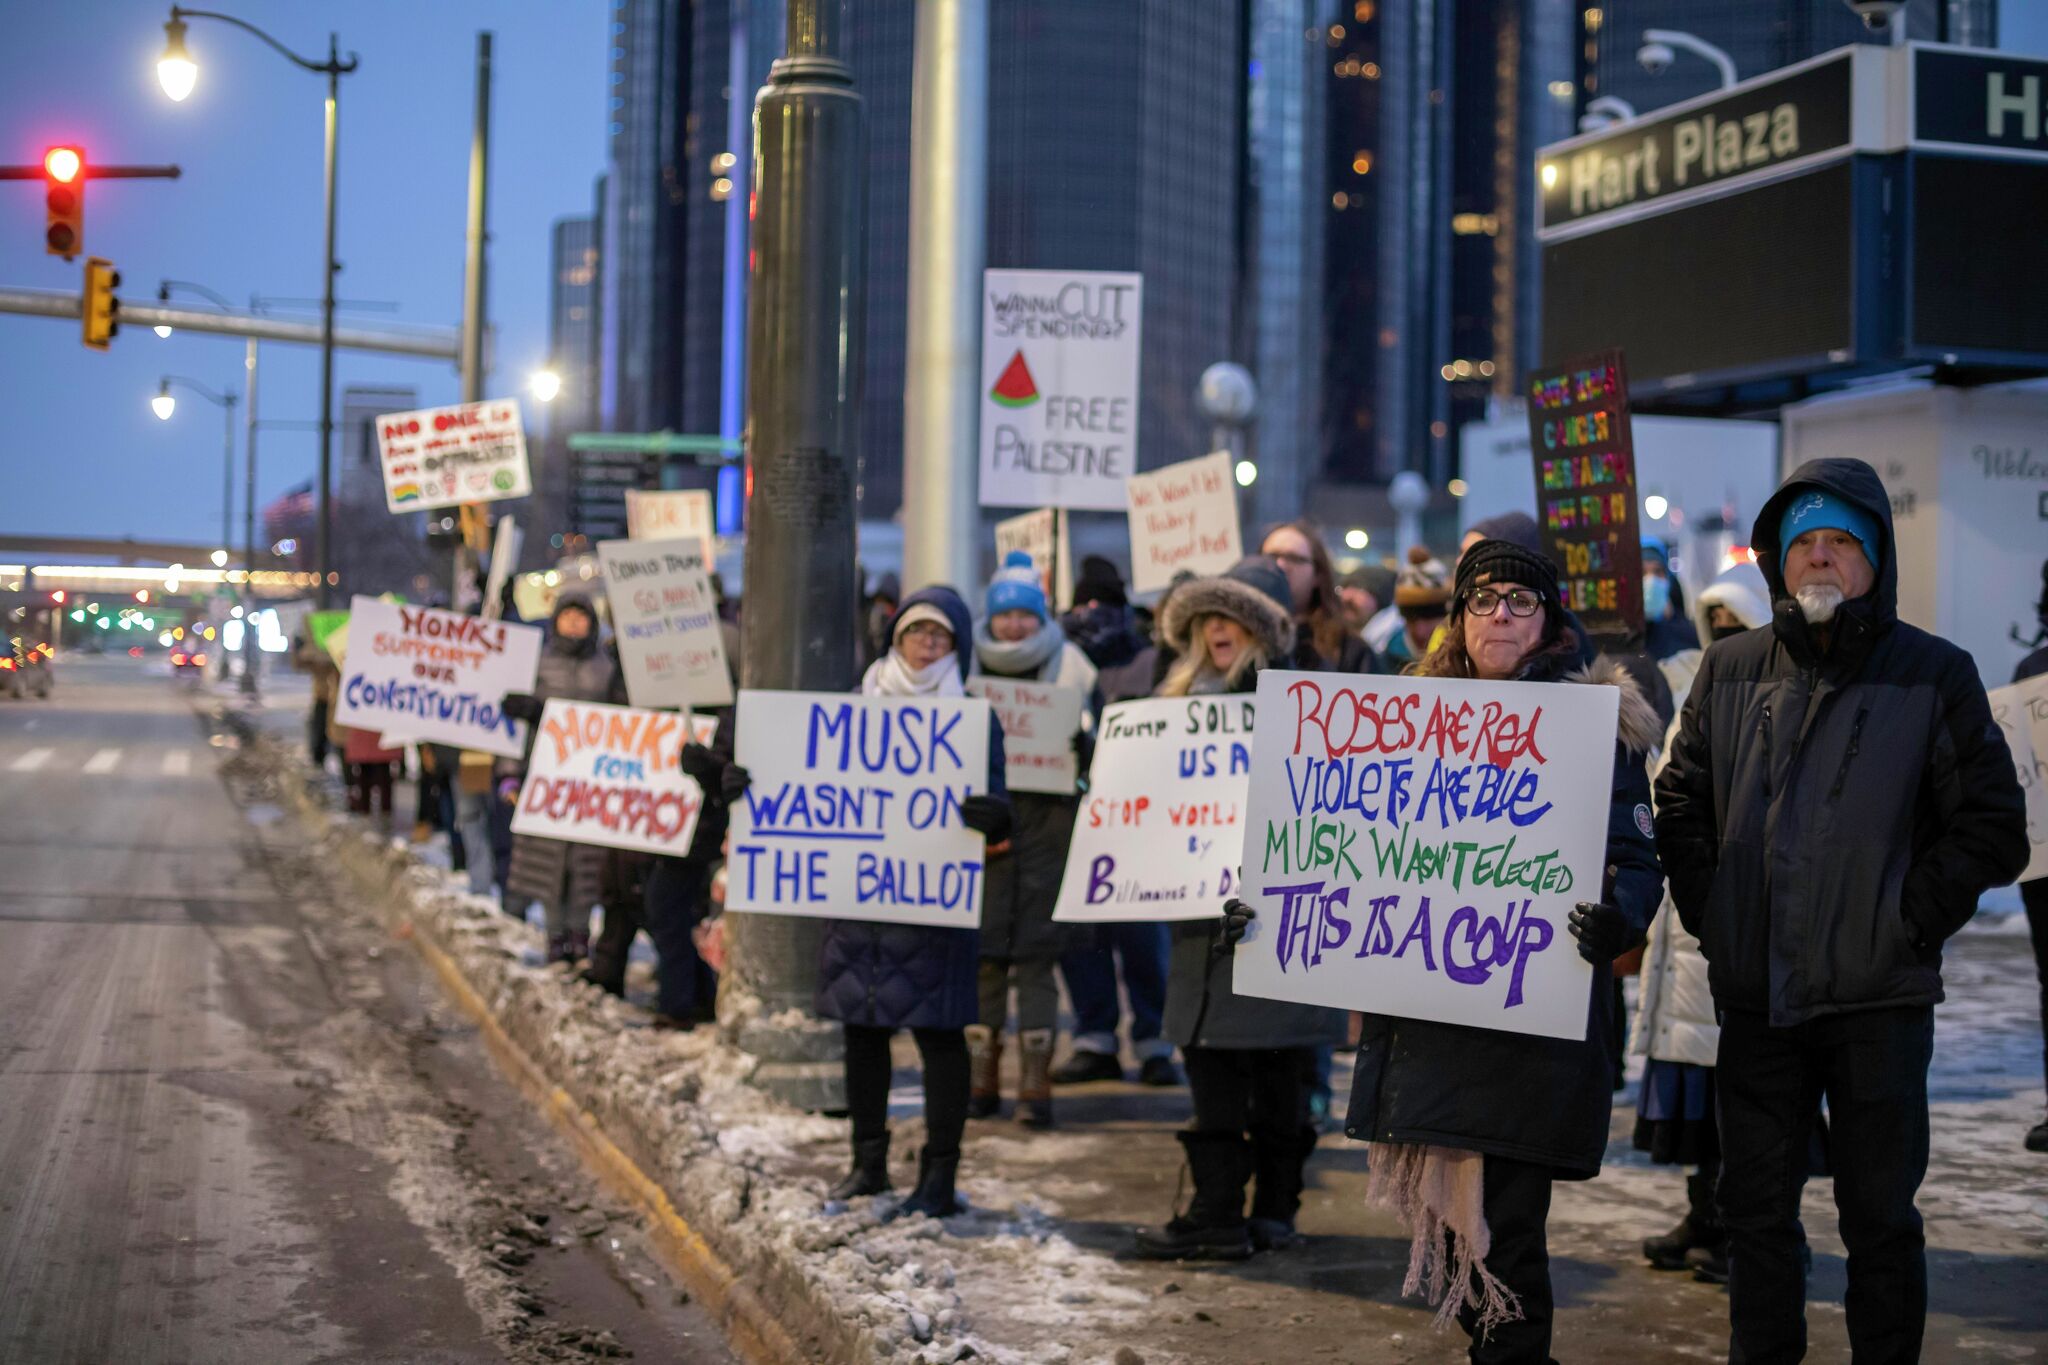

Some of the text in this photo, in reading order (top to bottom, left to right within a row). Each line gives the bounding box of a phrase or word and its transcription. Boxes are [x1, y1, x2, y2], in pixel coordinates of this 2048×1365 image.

[1986, 71, 2048, 140] H
[1569, 102, 1800, 215] Hart Plaza
[989, 281, 1135, 323] WANNA CUT
[993, 313, 1128, 339] SPENDING?
[1045, 395, 1129, 434] FREE
[1543, 410, 1609, 449] CANCER
[372, 631, 486, 670] SUPPORT
[399, 607, 506, 654] HONK!
[806, 703, 963, 776] MUSK
[1185, 701, 1255, 735] SOLD
[594, 753, 645, 780] FOR
[522, 775, 698, 841] DEMOCRACY
[743, 782, 973, 830] WASN'T ON
[1262, 814, 1363, 882] MUSK
[736, 845, 829, 902] THE
[857, 852, 983, 912] BALLOT
[1262, 881, 1353, 974] THIS
[1354, 895, 1401, 959] IS
[1391, 895, 1439, 972] A
